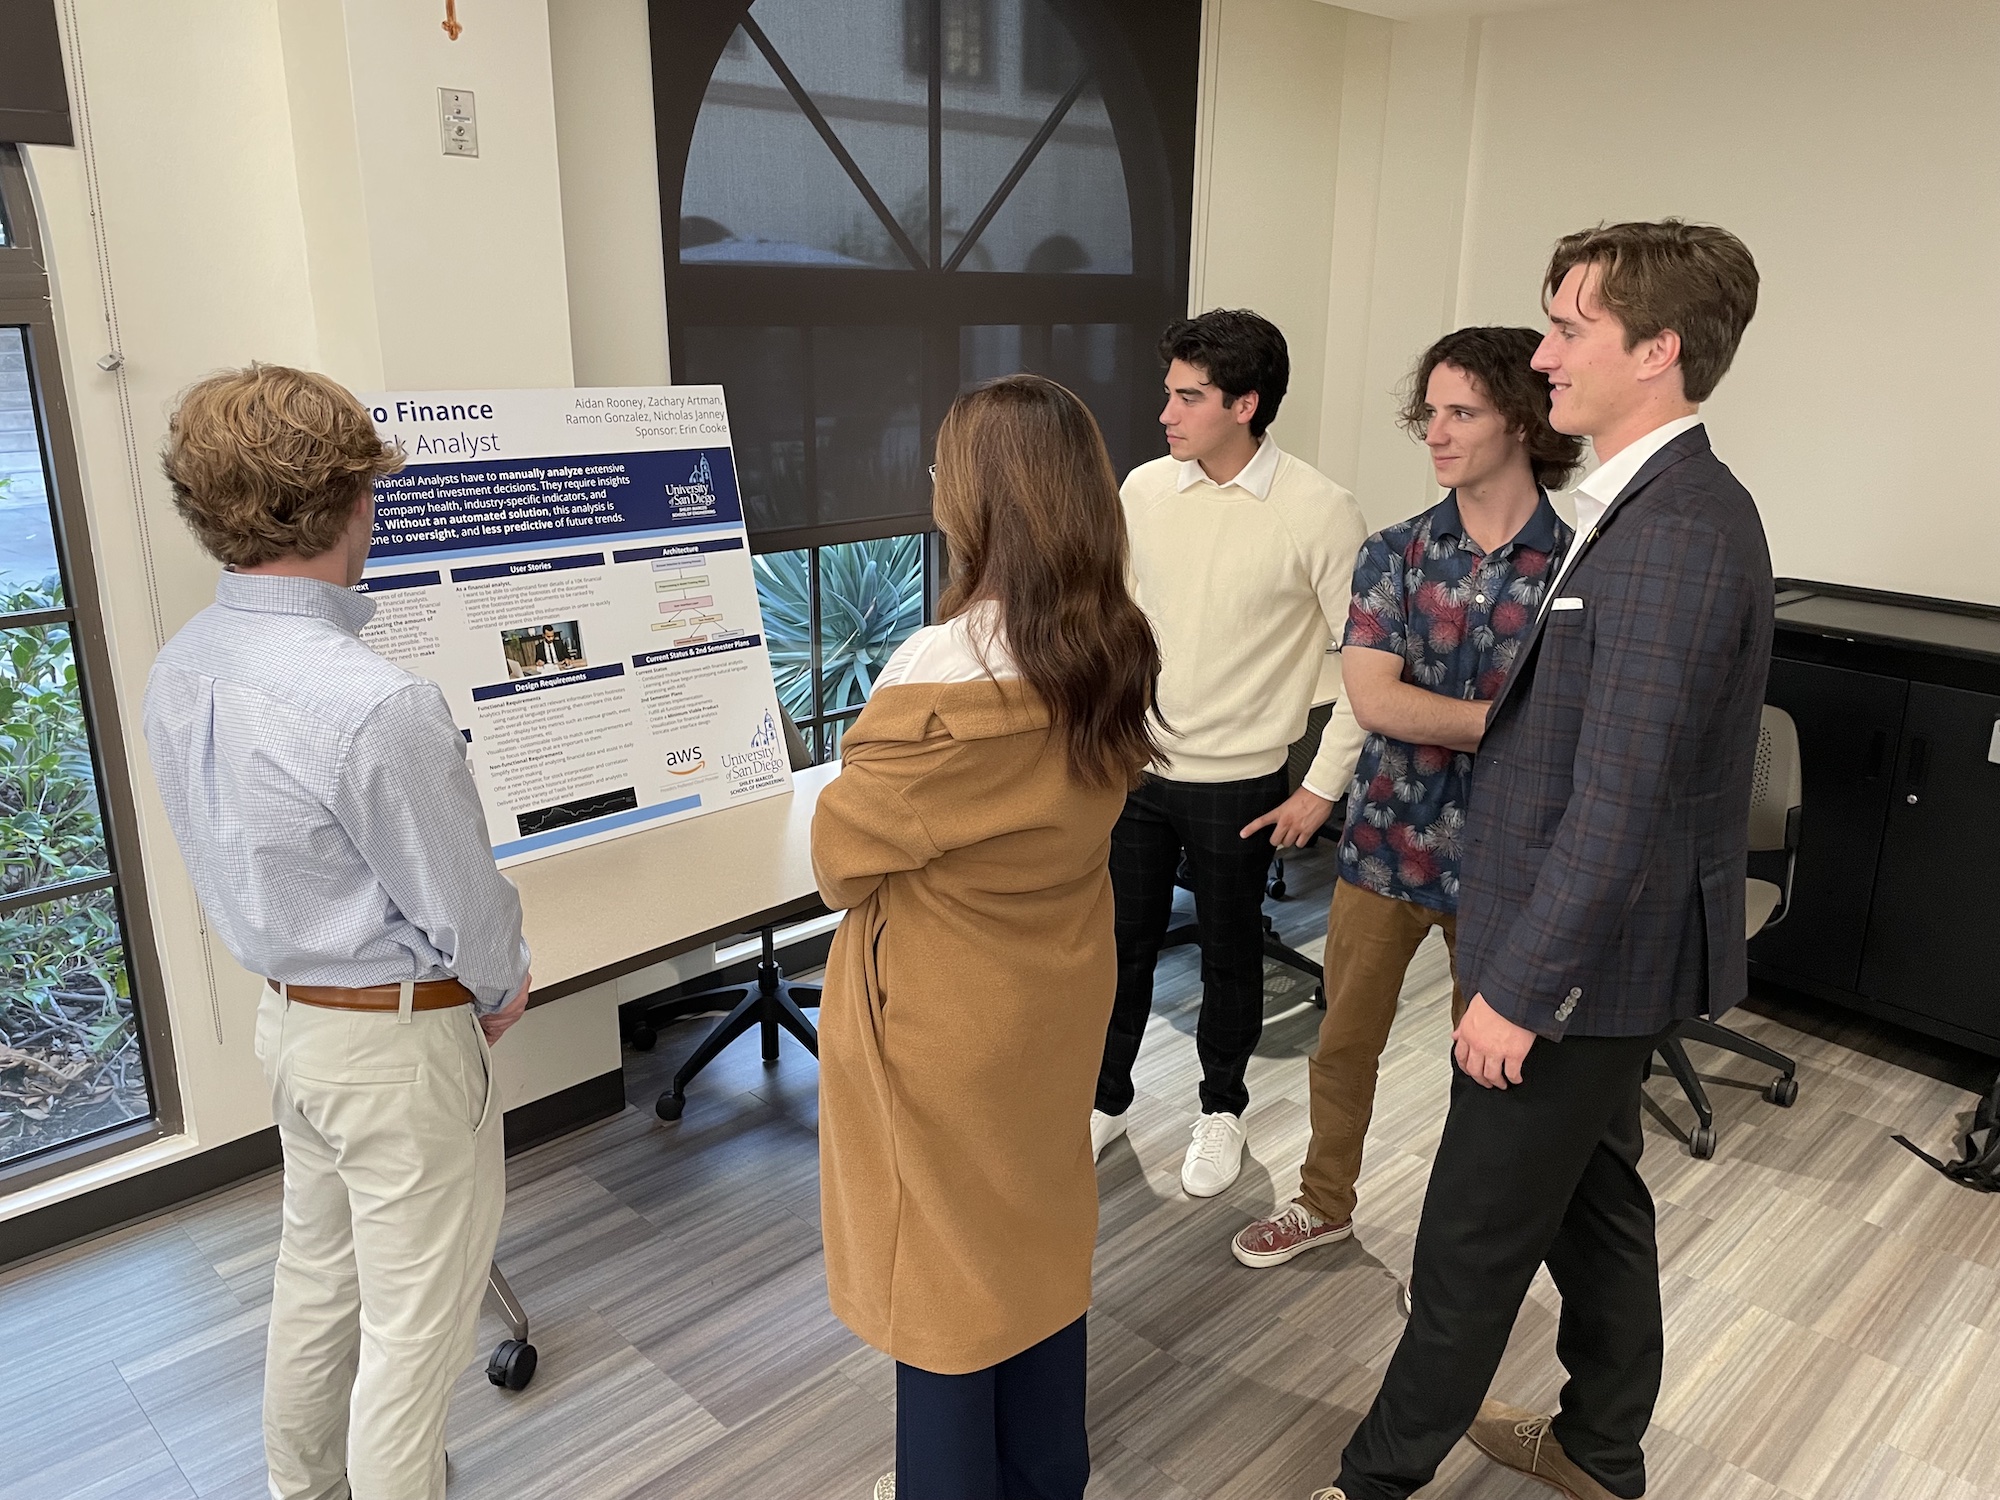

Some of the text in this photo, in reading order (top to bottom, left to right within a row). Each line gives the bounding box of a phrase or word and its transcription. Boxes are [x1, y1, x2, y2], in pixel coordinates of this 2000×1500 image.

[396, 401, 493, 422] Finance
[576, 396, 722, 410] Aidan Rooney, Zachary Artman,
[565, 410, 725, 424] Ramon Gonzalez, Nicholas Janney
[635, 423, 727, 439] Sponsor: Erin Cooke
[416, 432, 500, 458] Analyst
[373, 463, 625, 489] inancial Analysts have to manually analyze extensive
[386, 488, 435, 502] informed
[436, 486, 492, 498] investment
[493, 483, 539, 494] decisions.
[540, 480, 562, 492] They
[564, 478, 596, 490] require
[597, 476, 630, 487] insights
[665, 483, 708, 496] University
[378, 489, 606, 517] company health, industry-specific indicators, and
[668, 494, 716, 507] of San Diego
[384, 517, 431, 530] Without
[433, 517, 447, 526] an
[449, 510, 507, 524] automated
[508, 507, 551, 519] solution,
[553, 505, 570, 515] this
[571, 502, 606, 514] analysis
[607, 501, 614, 510] is
[371, 513, 625, 545] one to oversight, and less predictive of future trends.
[663, 546, 699, 556] Architecture
[527, 562, 551, 571] Stories
[364, 622, 393, 630] outpacing
[646, 640, 750, 663] Current Status & 2nd Semester Plans
[515, 674, 587, 692] Design Requirements
[666, 746, 702, 766] aws
[721, 747, 774, 768] University
[726, 760, 784, 781] of San Diego
[730, 787, 748, 795] SCHOOL
[756, 778, 784, 788] ENGINEERING
[739, 774, 774, 787] SHILEY-MARCOS
